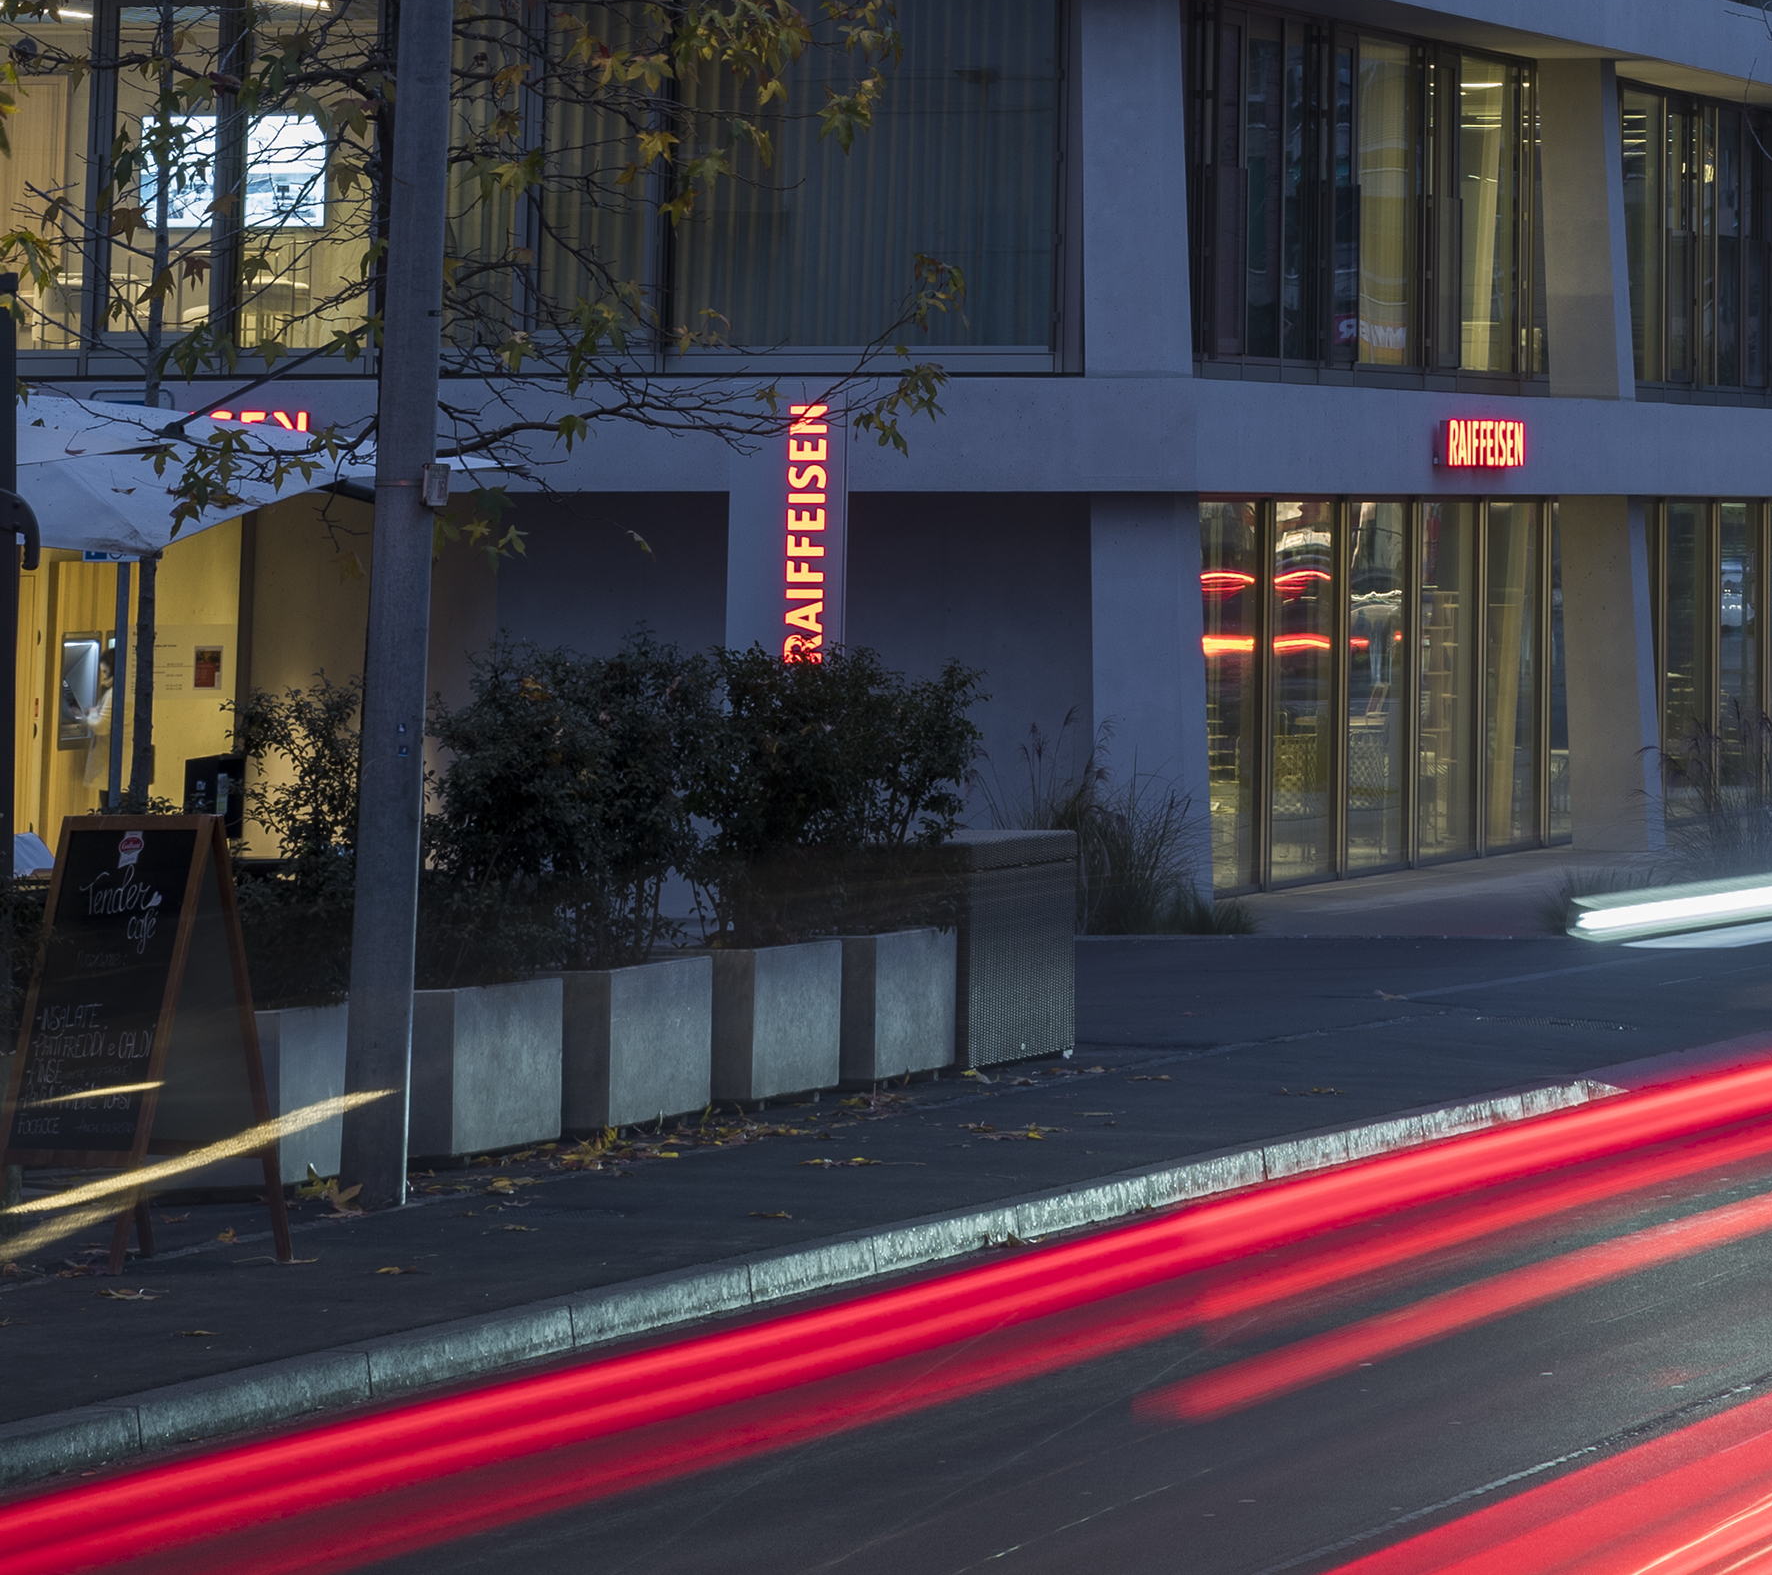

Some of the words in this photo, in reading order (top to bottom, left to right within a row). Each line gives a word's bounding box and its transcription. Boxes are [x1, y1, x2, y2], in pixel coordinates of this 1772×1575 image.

[1448, 419, 1524, 467] RAIFFEISEN
[783, 404, 828, 664] RAIFFEISEN
[79, 864, 152, 915] Tender
[127, 909, 158, 954] café
